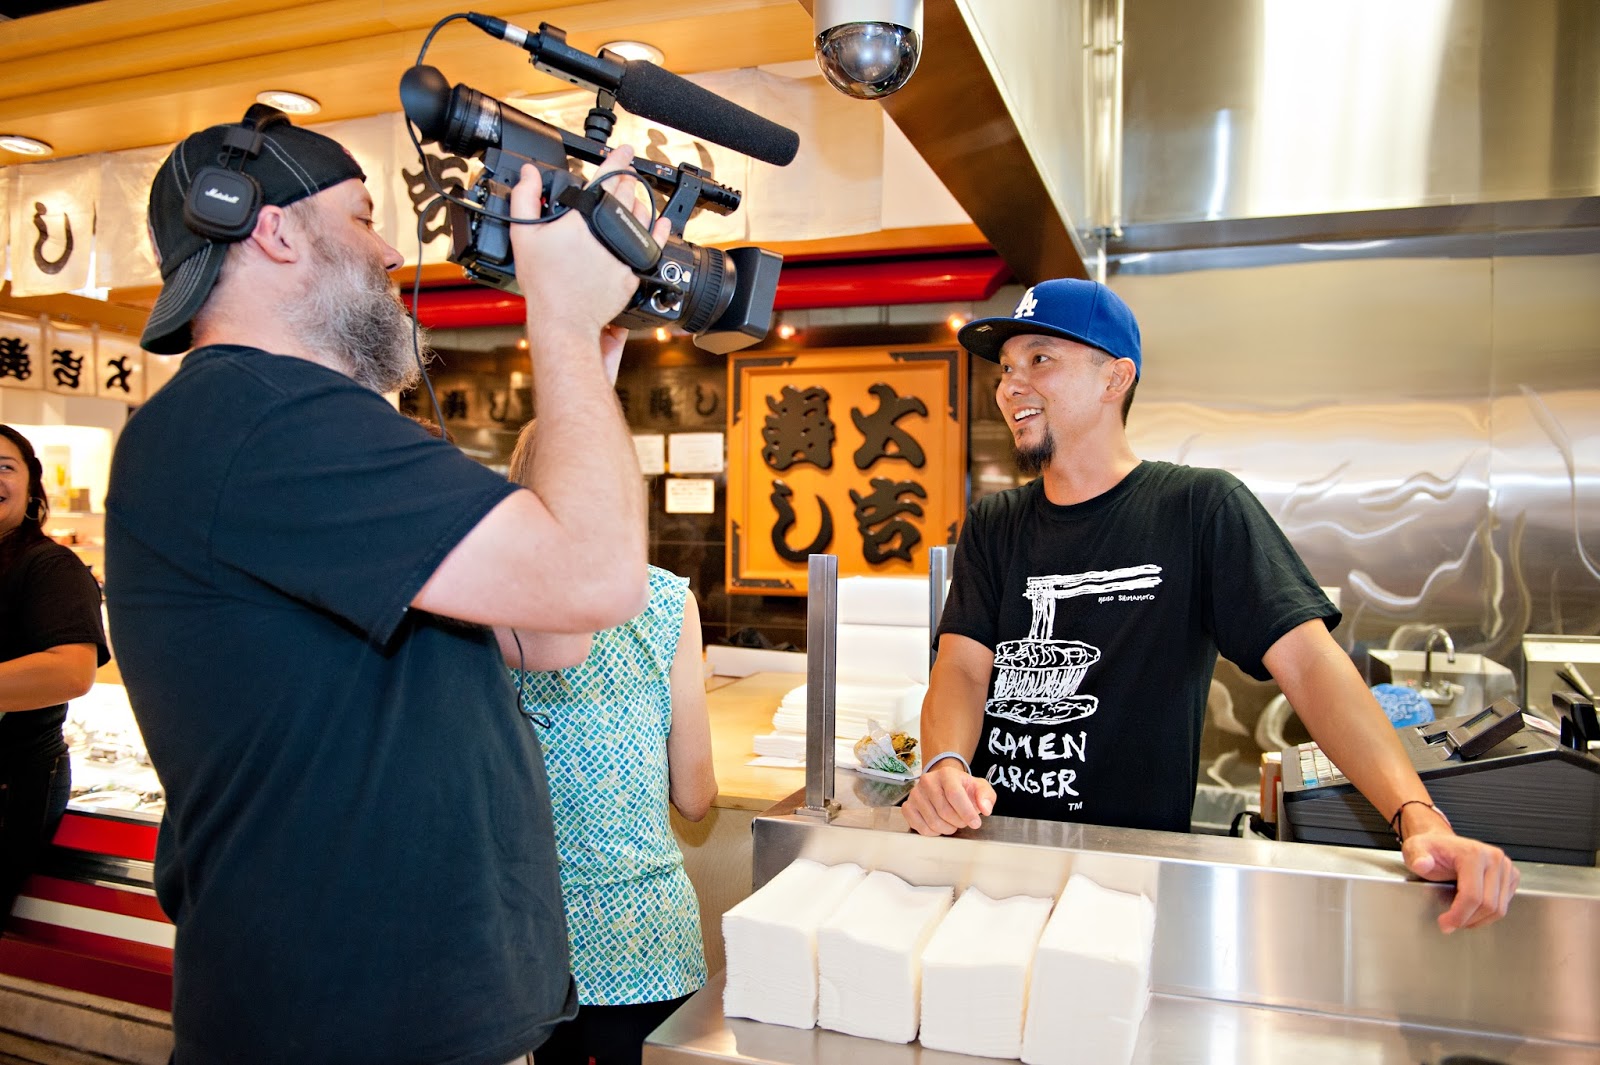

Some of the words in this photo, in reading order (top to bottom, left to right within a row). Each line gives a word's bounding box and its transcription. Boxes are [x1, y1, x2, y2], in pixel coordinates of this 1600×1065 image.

[615, 206, 649, 248] Panasonic
[1014, 287, 1038, 318] LA
[988, 727, 1088, 762] RAMEN
[984, 763, 1080, 798] URGER
[1068, 801, 1083, 811] TM
